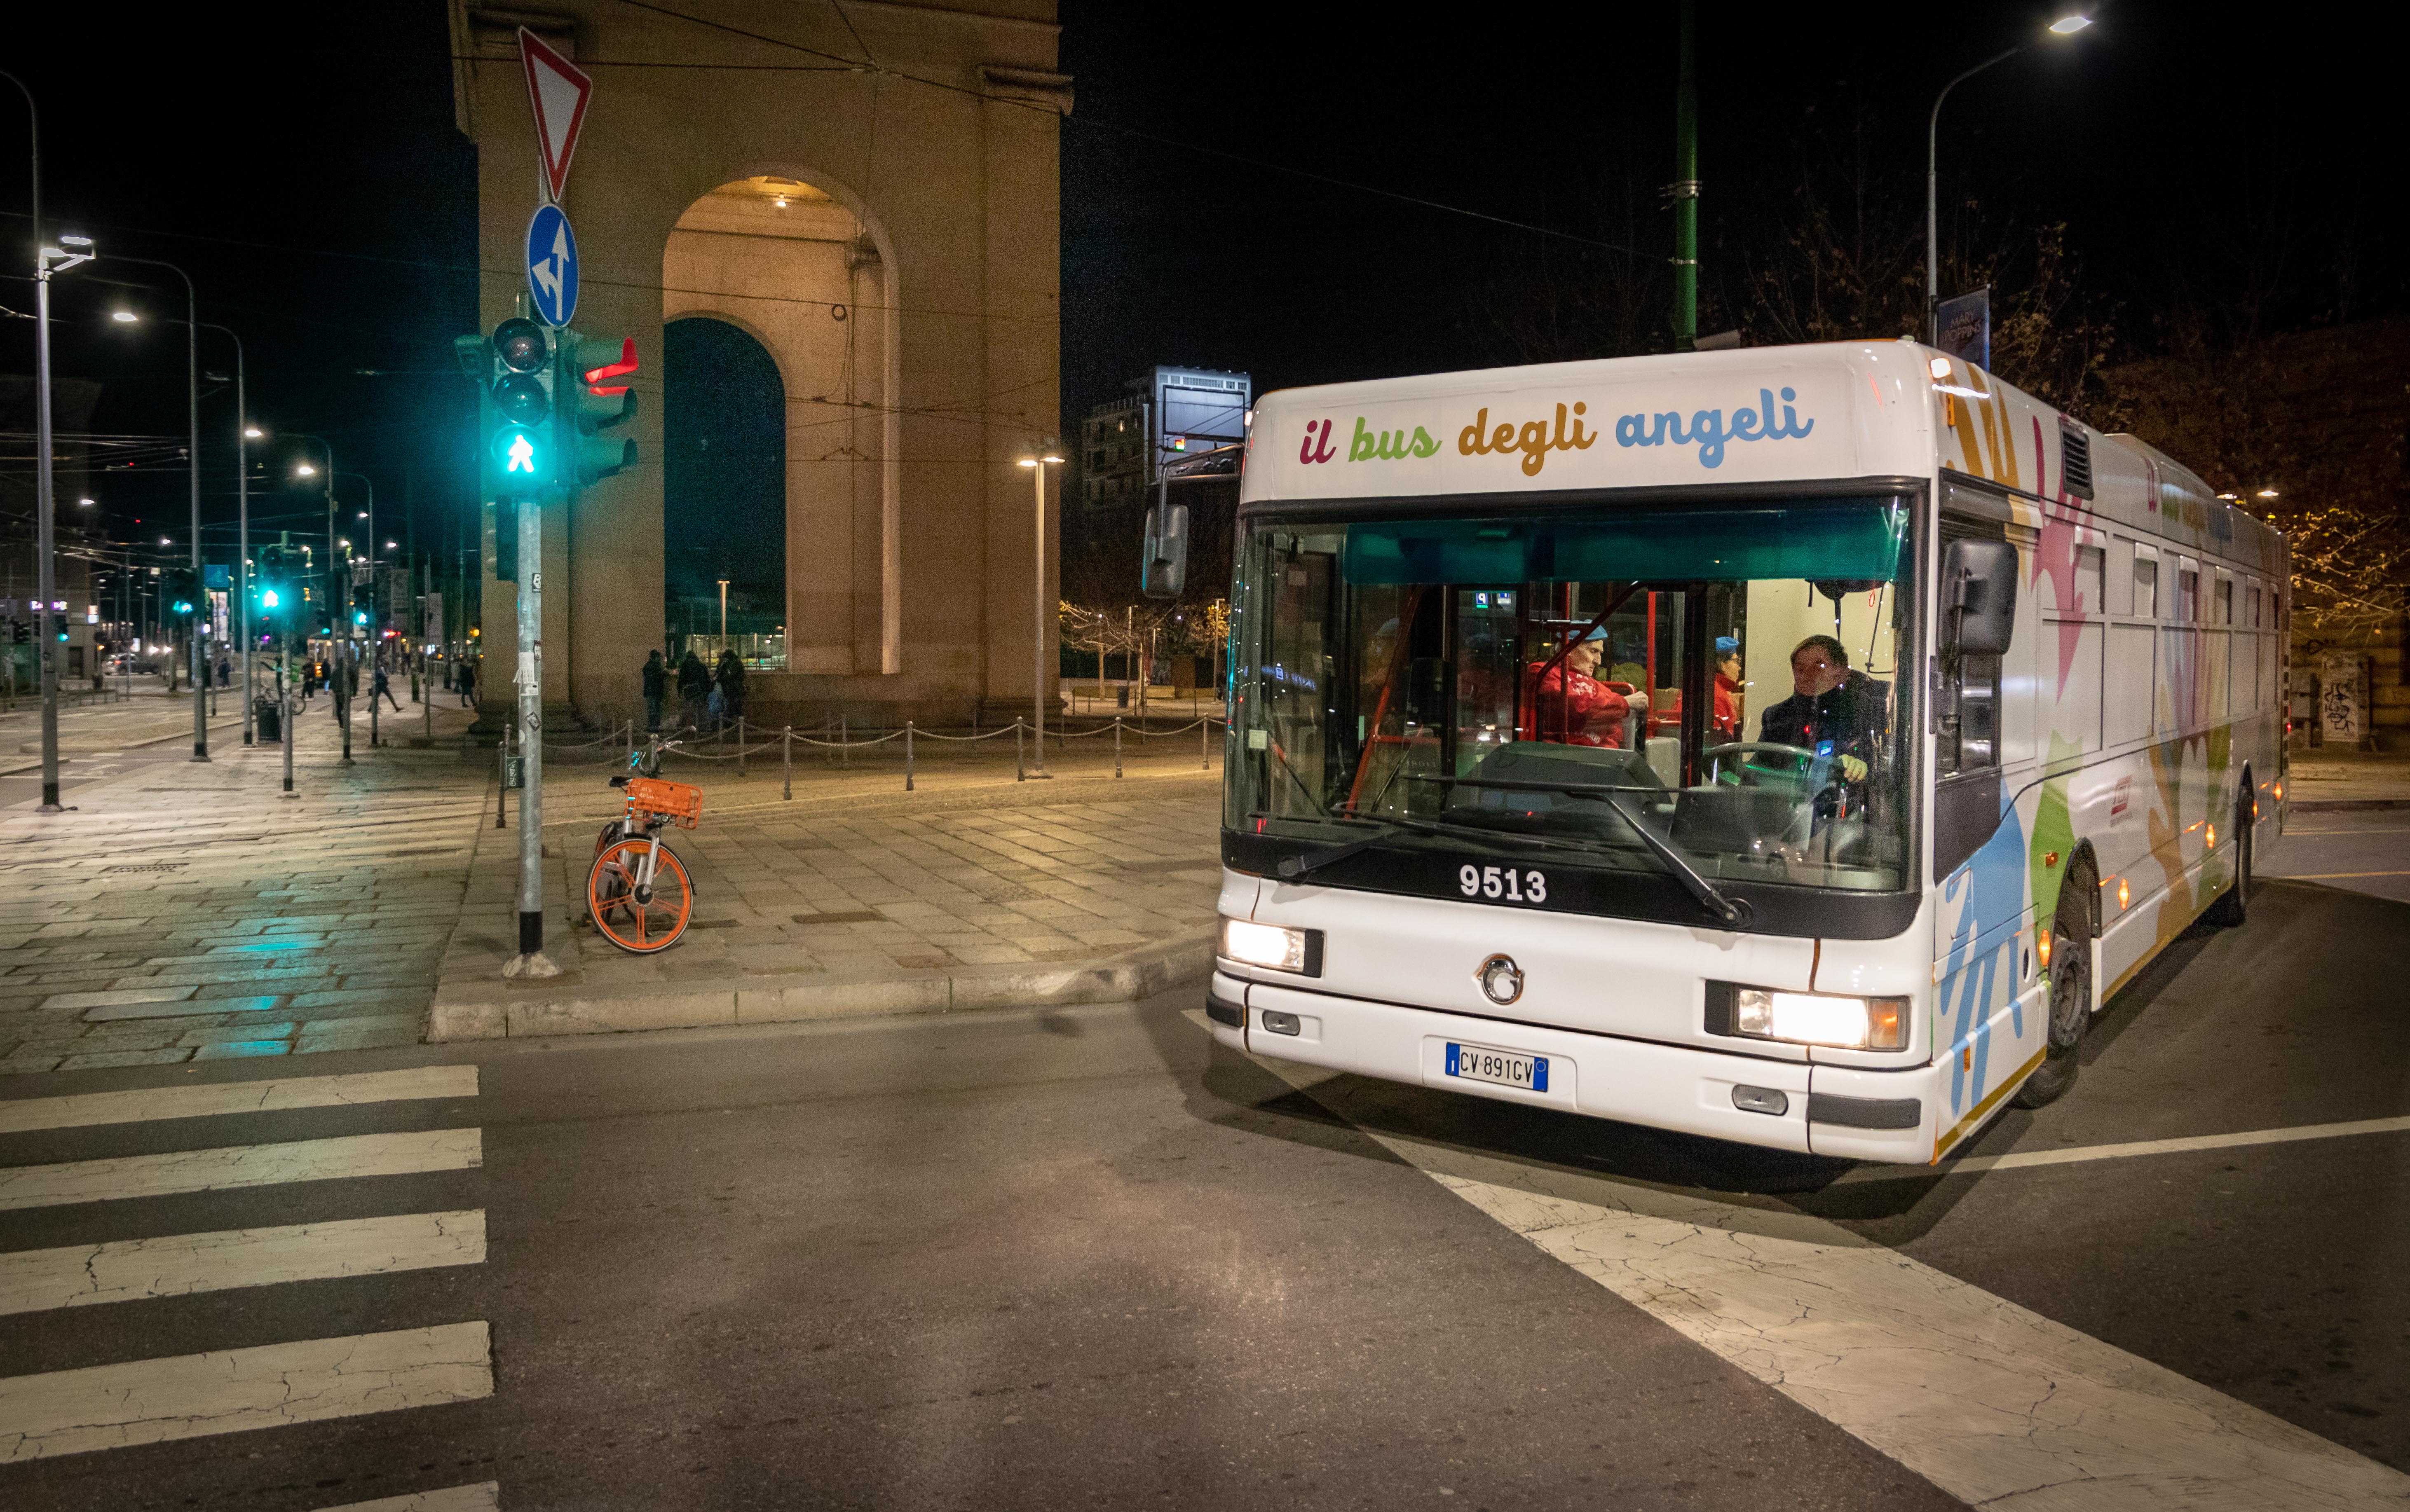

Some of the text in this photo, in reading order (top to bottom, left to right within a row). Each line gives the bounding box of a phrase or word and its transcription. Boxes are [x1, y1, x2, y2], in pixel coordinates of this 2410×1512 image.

[1299, 386, 1815, 477] il bus degli angeli
[1460, 864, 1546, 902] 9513
